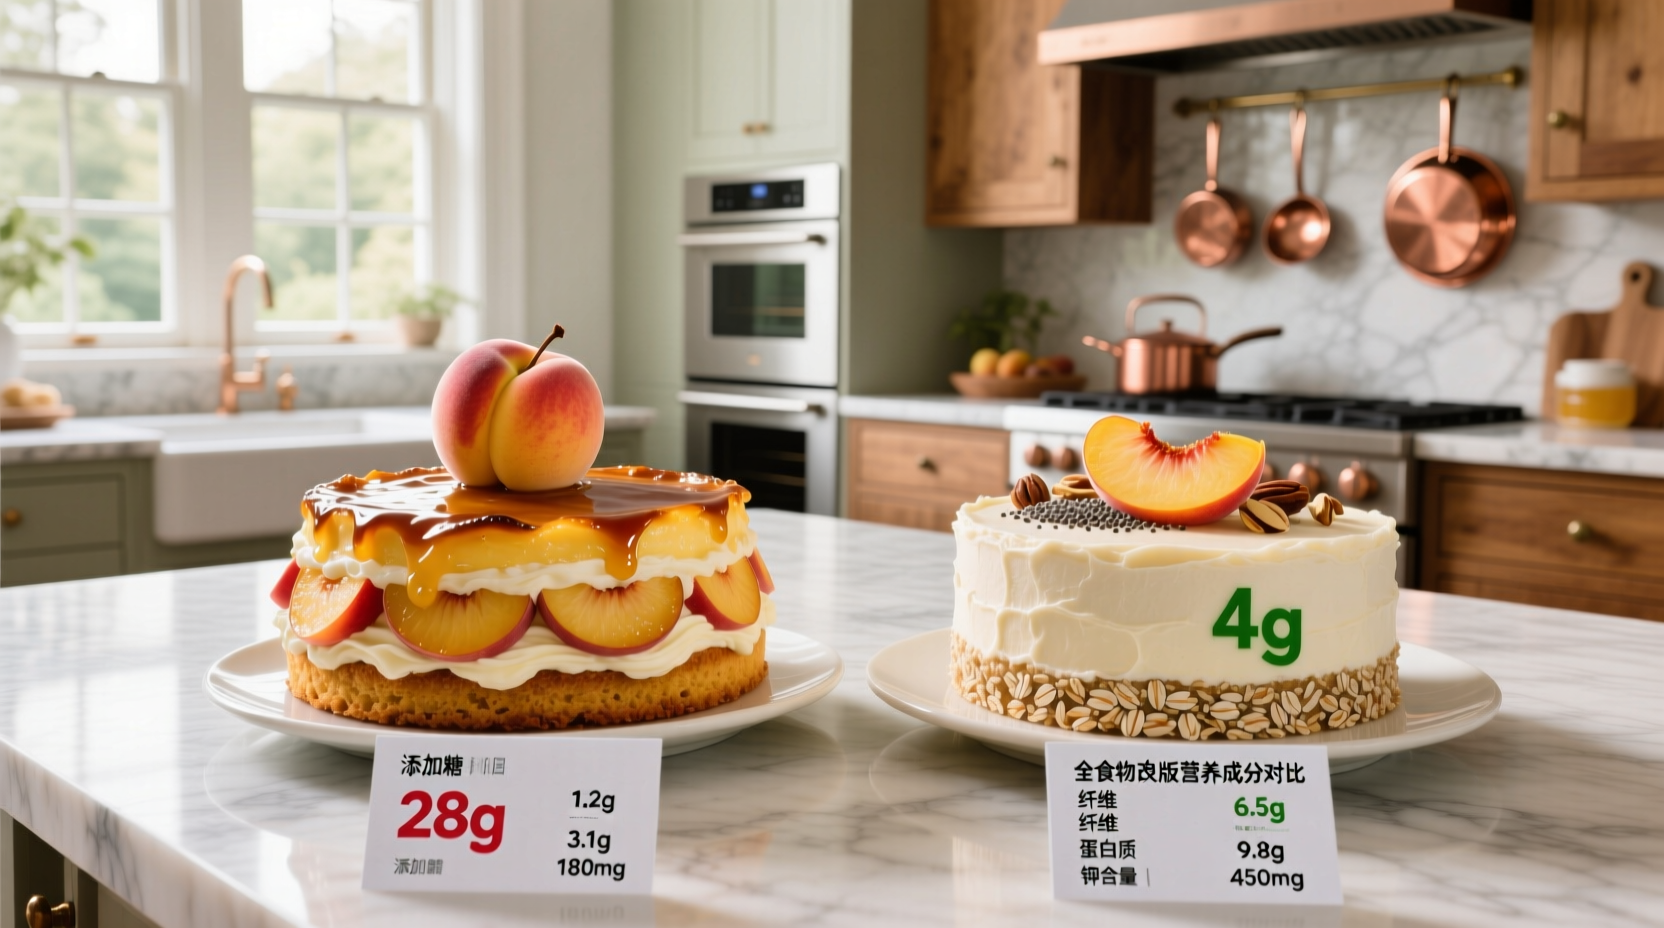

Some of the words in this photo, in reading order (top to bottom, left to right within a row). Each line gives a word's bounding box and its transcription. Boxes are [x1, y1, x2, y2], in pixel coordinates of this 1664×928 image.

[1212, 587, 1302, 667] 4g
[401, 753, 463, 777] 添加糖
[572, 790, 616, 814] 1.2g
[1078, 789, 1118, 810] 纤维
[1234, 796, 1286, 824] 6.5g
[396, 790, 505, 854] 28g
[1079, 812, 1120, 833] 纤维
[567, 830, 611, 854] 3.1g
[1080, 839, 1137, 860] 蛋白质
[1237, 841, 1285, 864] 9.8g
[557, 858, 626, 881] 180mg
[1230, 868, 1304, 892] 450mg
